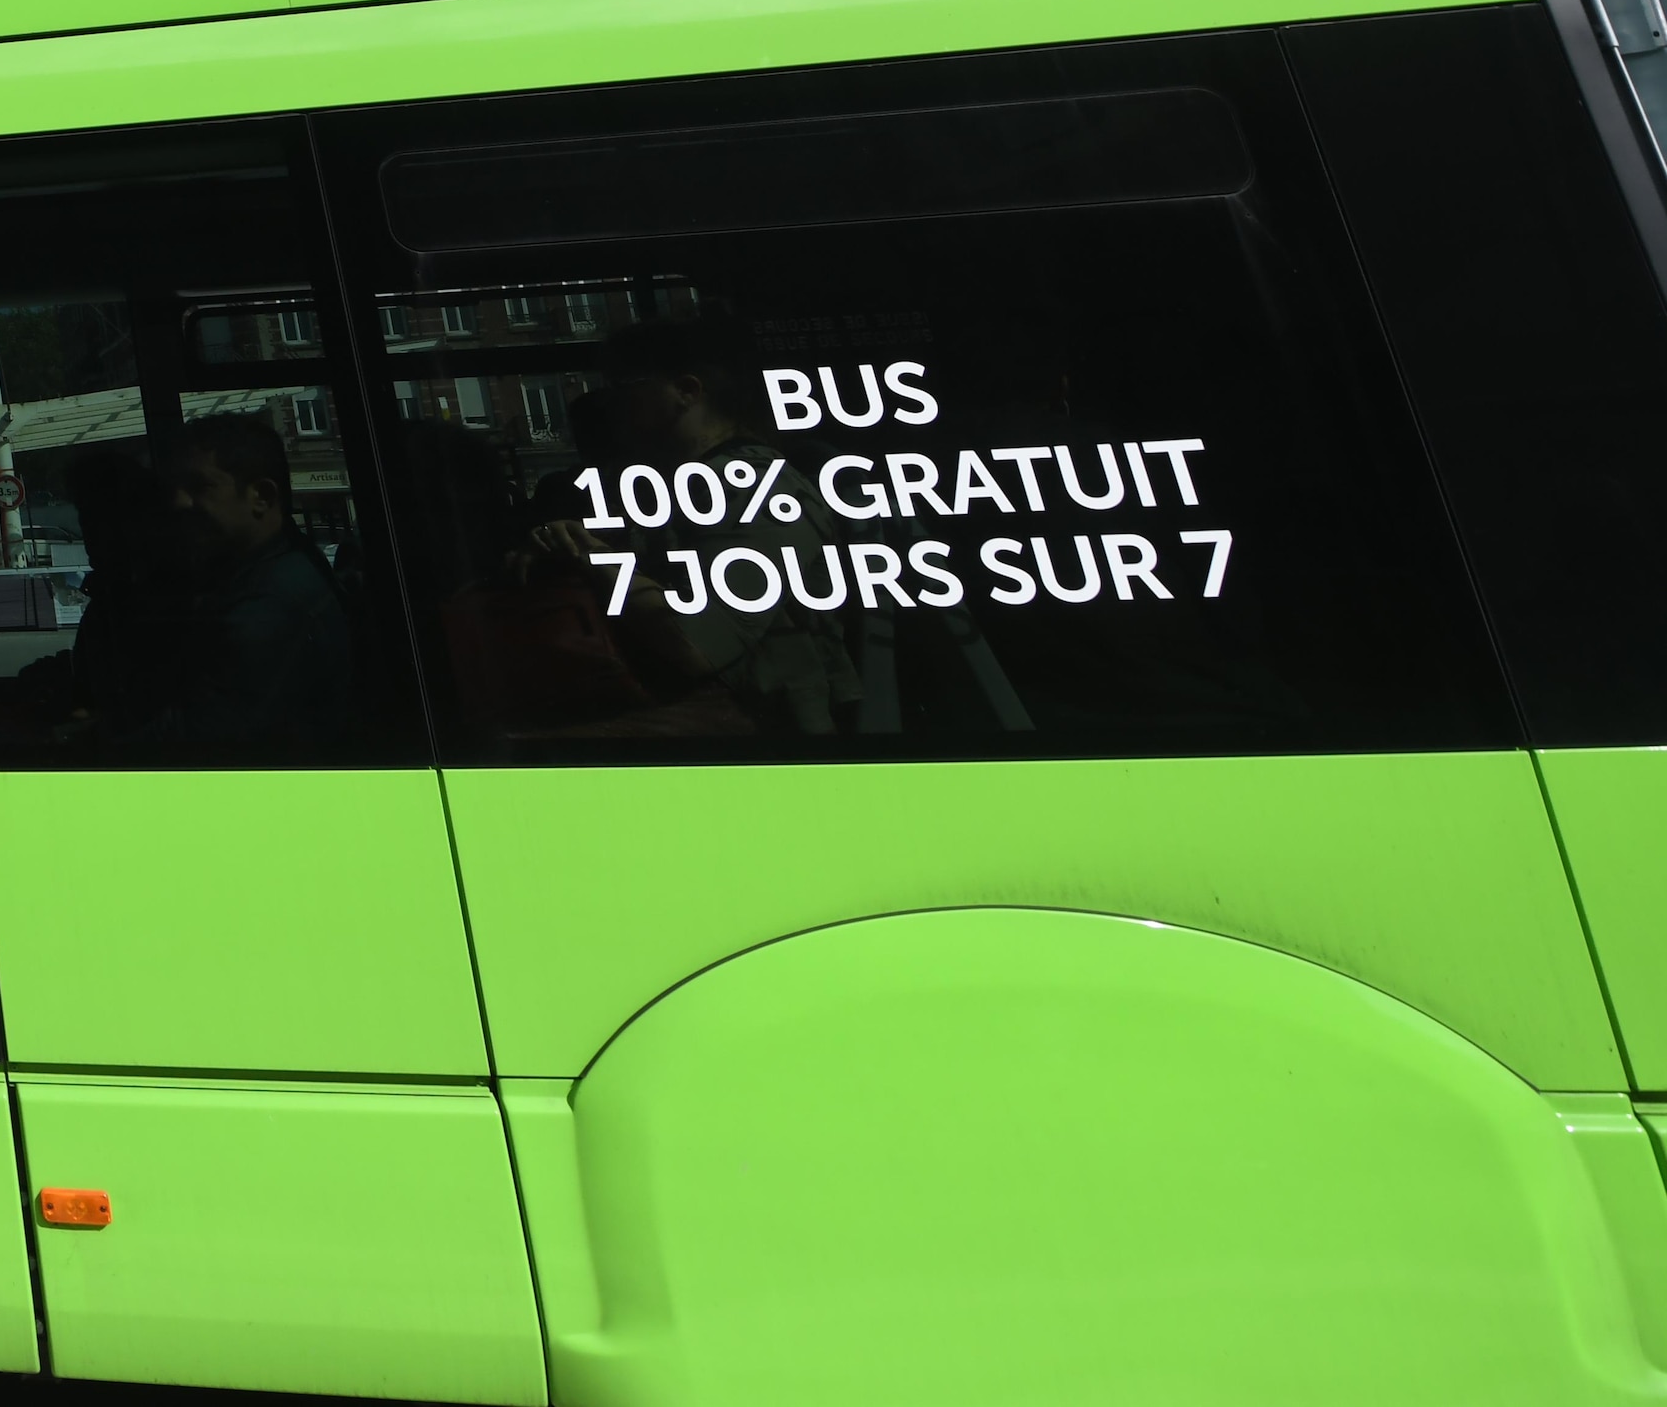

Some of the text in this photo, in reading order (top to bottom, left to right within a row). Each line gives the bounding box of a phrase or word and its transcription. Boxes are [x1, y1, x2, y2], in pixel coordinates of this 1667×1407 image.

[763, 361, 939, 431] BUS
[574, 438, 1205, 528] 100% GRATUIT
[589, 530, 1233, 616] 7 JOURS SUR 7
